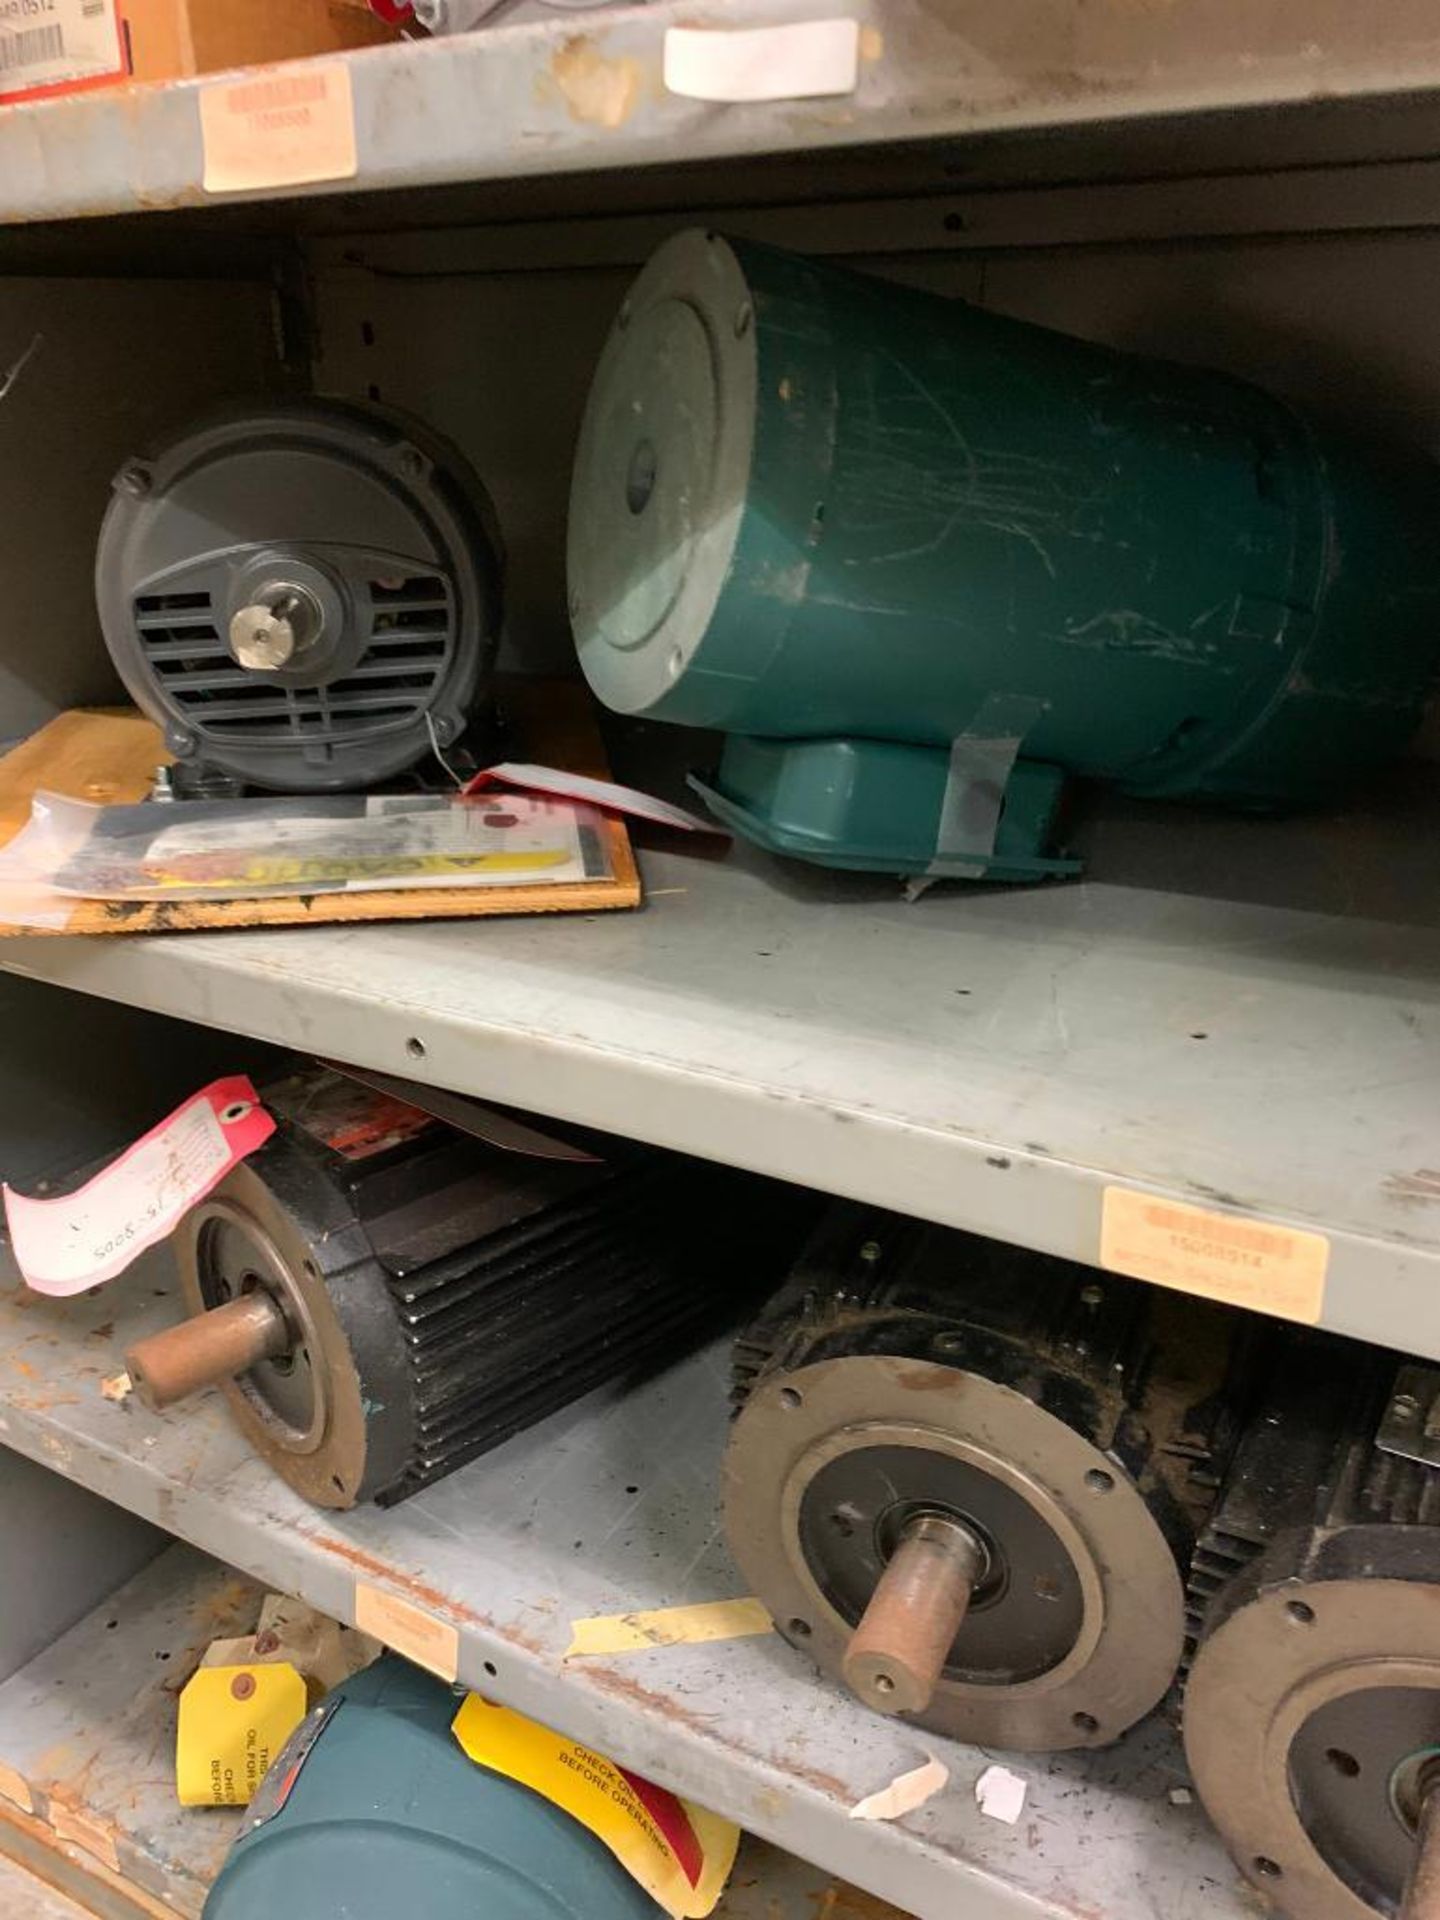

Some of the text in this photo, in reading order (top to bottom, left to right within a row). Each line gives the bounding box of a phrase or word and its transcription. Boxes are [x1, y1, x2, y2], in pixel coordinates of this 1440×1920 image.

[247, 1729, 257, 1751] OIL
[246, 1752, 256, 1779] FOR
[574, 1746, 617, 1783] CHECK
[558, 1752, 669, 1858] BEFORE OPERATING
